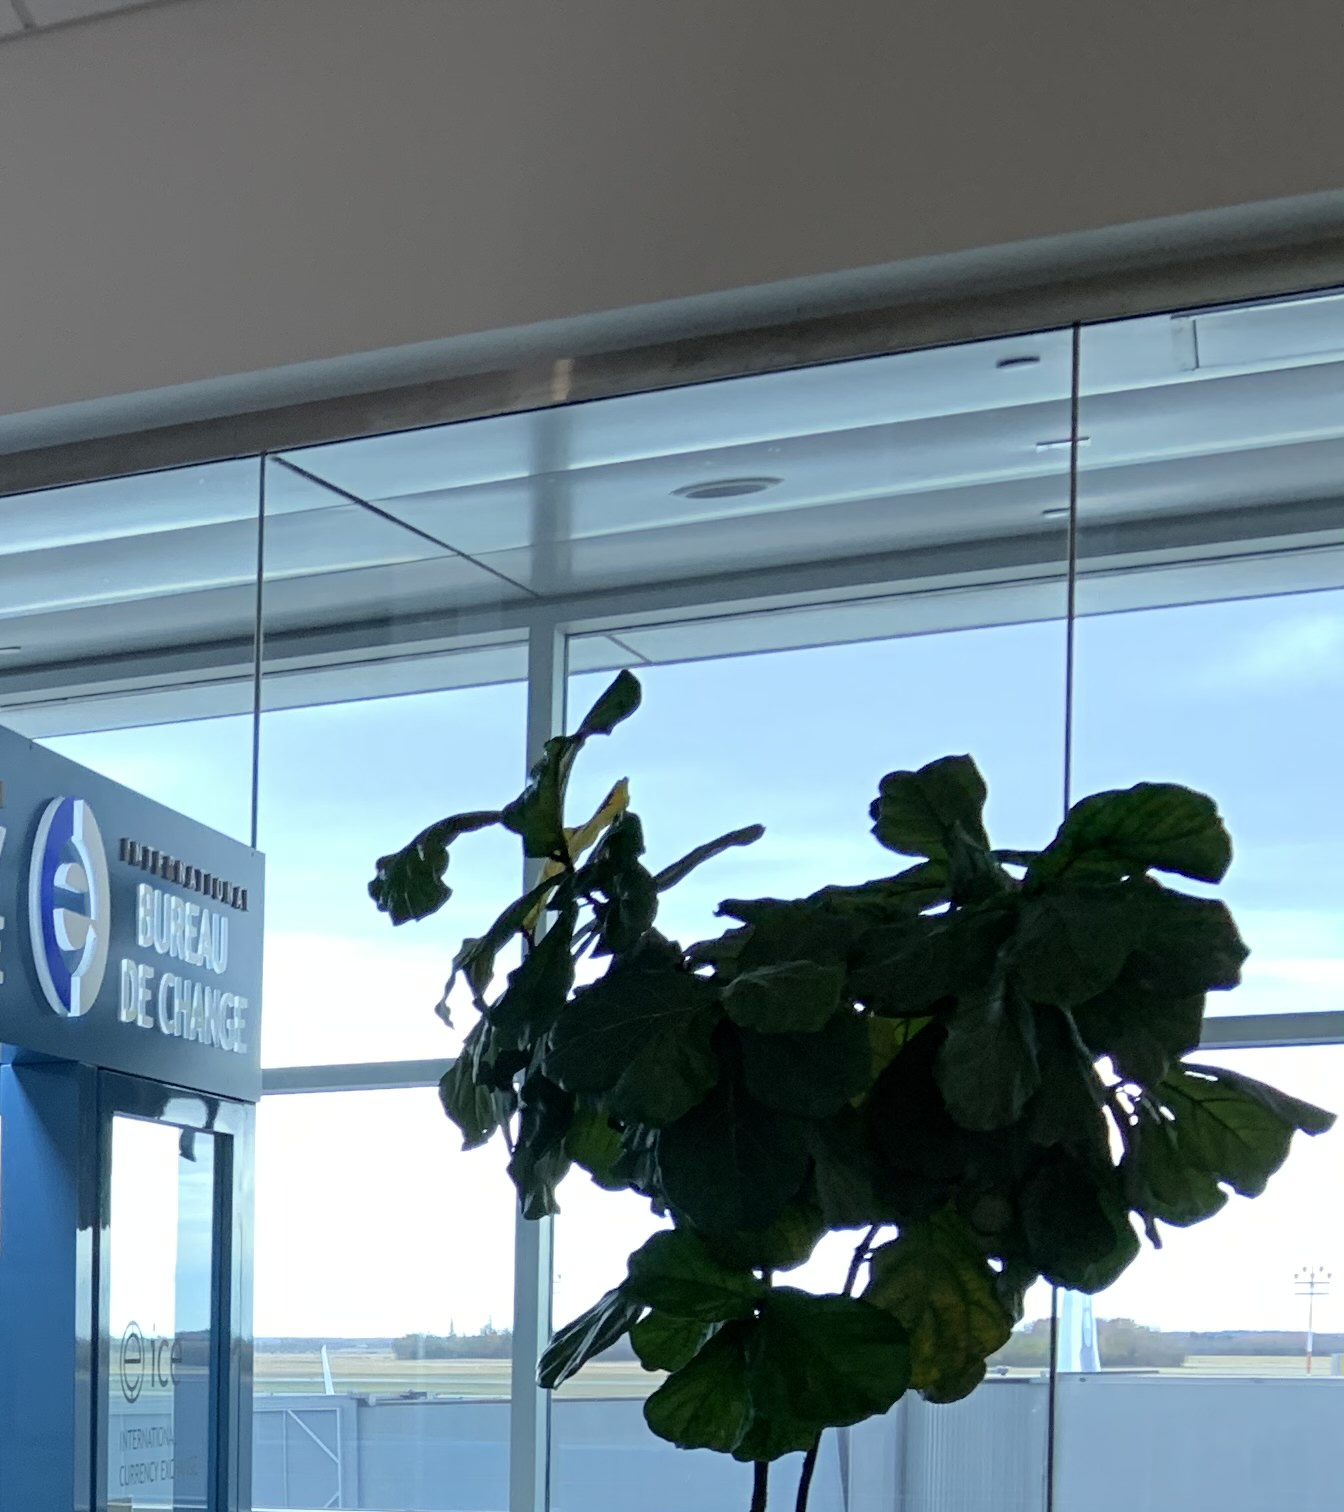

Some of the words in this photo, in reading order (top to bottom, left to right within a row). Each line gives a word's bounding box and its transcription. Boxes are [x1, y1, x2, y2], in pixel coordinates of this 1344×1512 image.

[137, 883, 228, 974] BUREAU
[120, 958, 155, 1029] DE
[158, 972, 249, 1054] CHANGE
